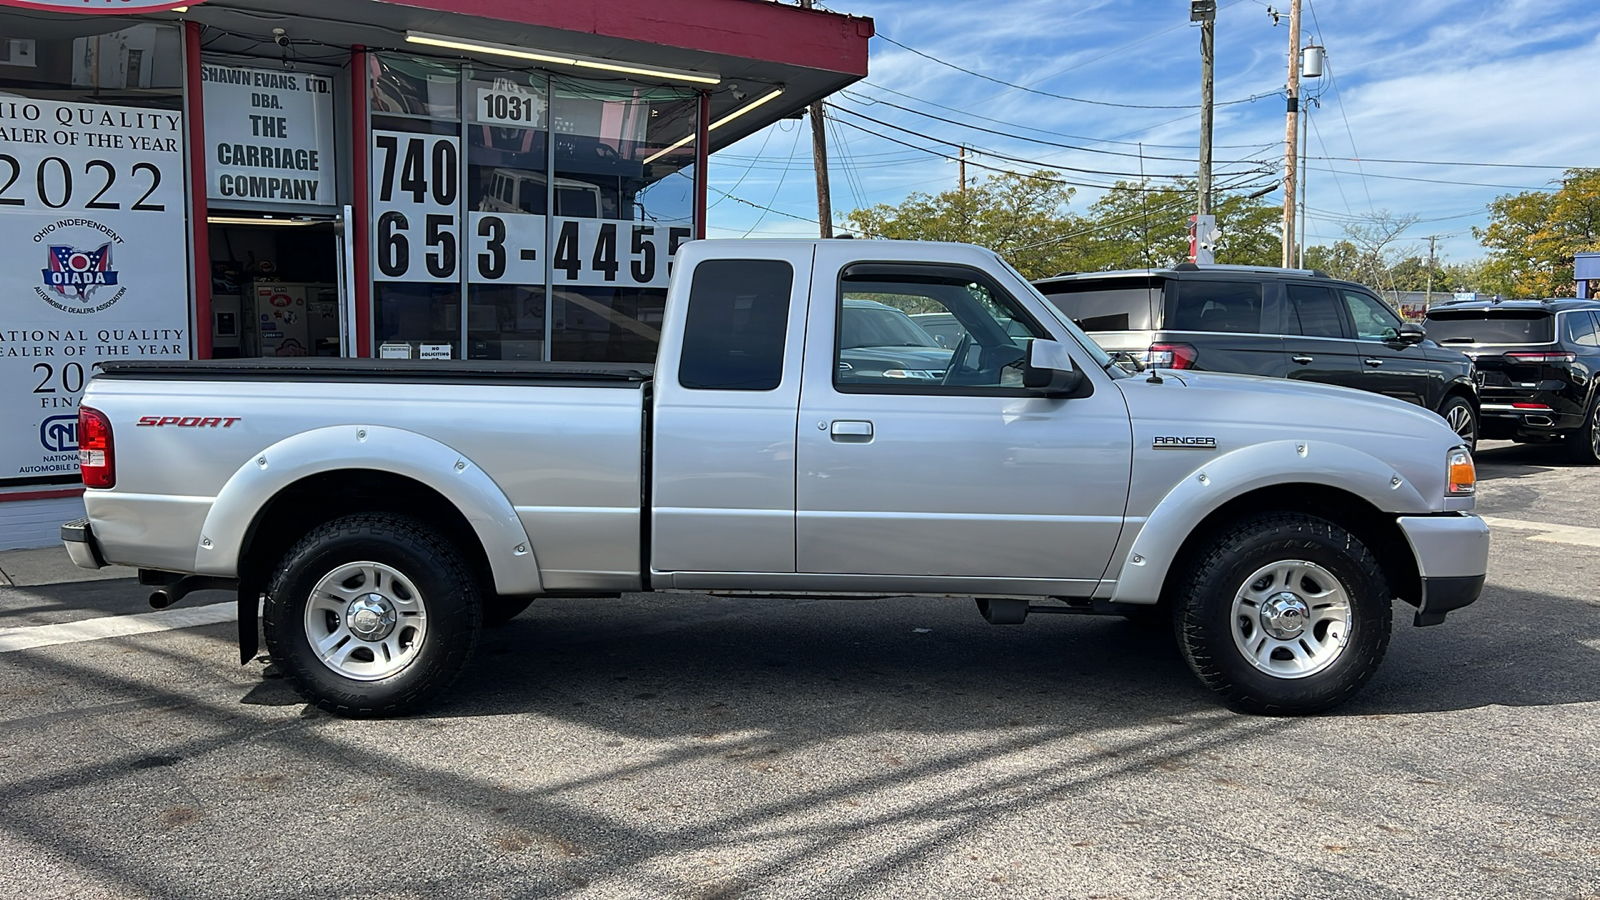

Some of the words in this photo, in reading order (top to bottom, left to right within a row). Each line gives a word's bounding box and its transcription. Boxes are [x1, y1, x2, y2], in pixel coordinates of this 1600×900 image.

[201, 66, 251, 86] SHAWN
[253, 72, 300, 91] EVANS.
[305, 77, 331, 94] LTD.
[251, 92, 283, 110] DBA.
[484, 93, 532, 122] 1031
[0, 102, 41, 121] IO
[55, 106, 180, 131] QUALITY
[249, 114, 288, 139] THE
[53, 130, 79, 146] OF
[84, 132, 124, 149] THE
[128, 135, 178, 152] YEAR
[217, 142, 319, 171] CARRIAGE
[0, 153, 166, 212] 2022
[376, 135, 459, 206] 740
[219, 174, 319, 201] COMPANY
[33, 223, 56, 243] OHIO
[56, 218, 125, 245] INDEPENDENT
[51, 271, 106, 285] OIADA
[33, 286, 69, 312] AUTOMOBILE
[67, 306, 96, 314] DEALERS
[96, 286, 127, 312] ASSOCIATION
[97, 329, 184, 343] QUALITY
[64, 345, 86, 356] OF
[95, 345, 129, 356] THE
[137, 344, 182, 355] YEAR
[136, 416, 242, 428] SPORT
[1154, 436, 1217, 445] RANGER
[19, 464, 71, 473] AUTOMOBILE
